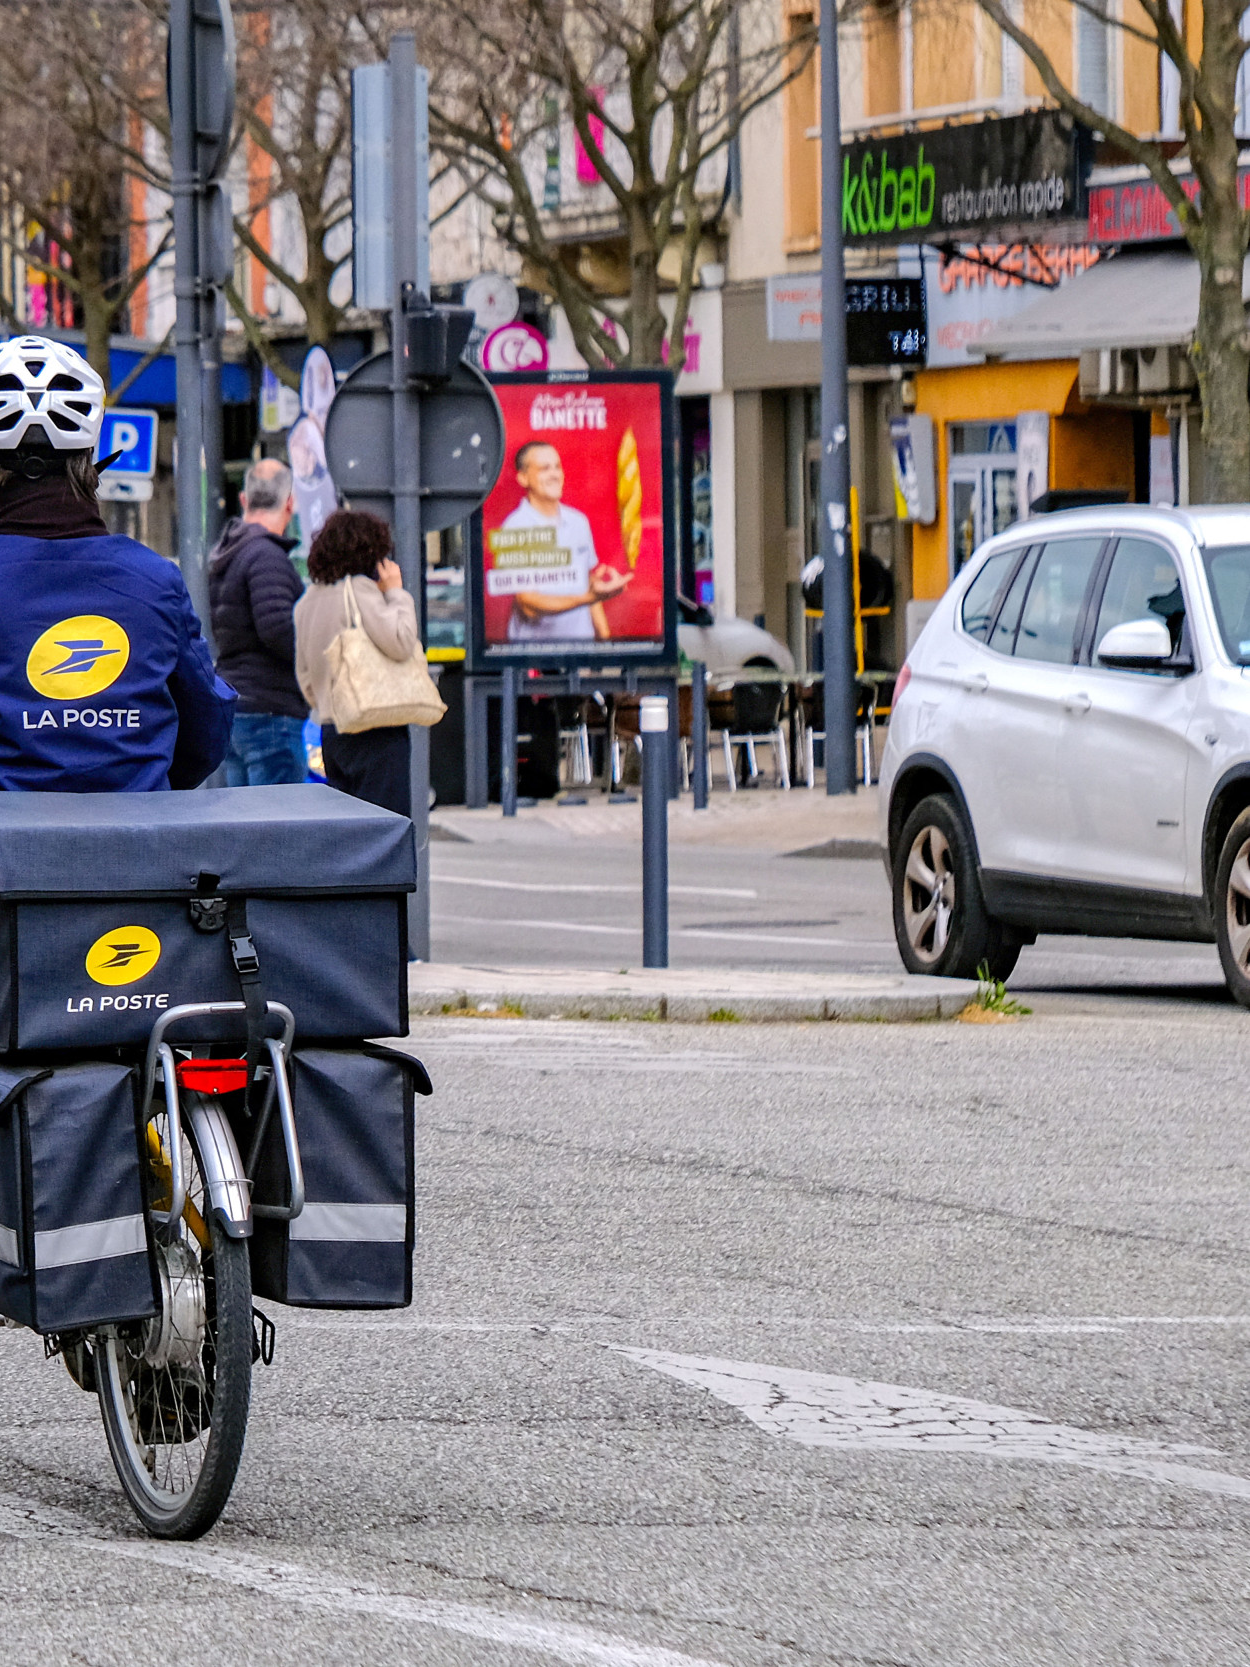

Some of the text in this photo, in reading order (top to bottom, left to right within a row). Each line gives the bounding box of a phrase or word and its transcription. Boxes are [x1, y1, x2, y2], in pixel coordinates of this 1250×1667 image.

[842, 142, 936, 235] k&bab
[941, 169, 1065, 223] restauration rapide
[530, 405, 607, 430] BANETTE
[111, 422, 139, 463] P
[23, 708, 140, 729] LA POSTE
[67, 994, 169, 1012] LA POSTE
